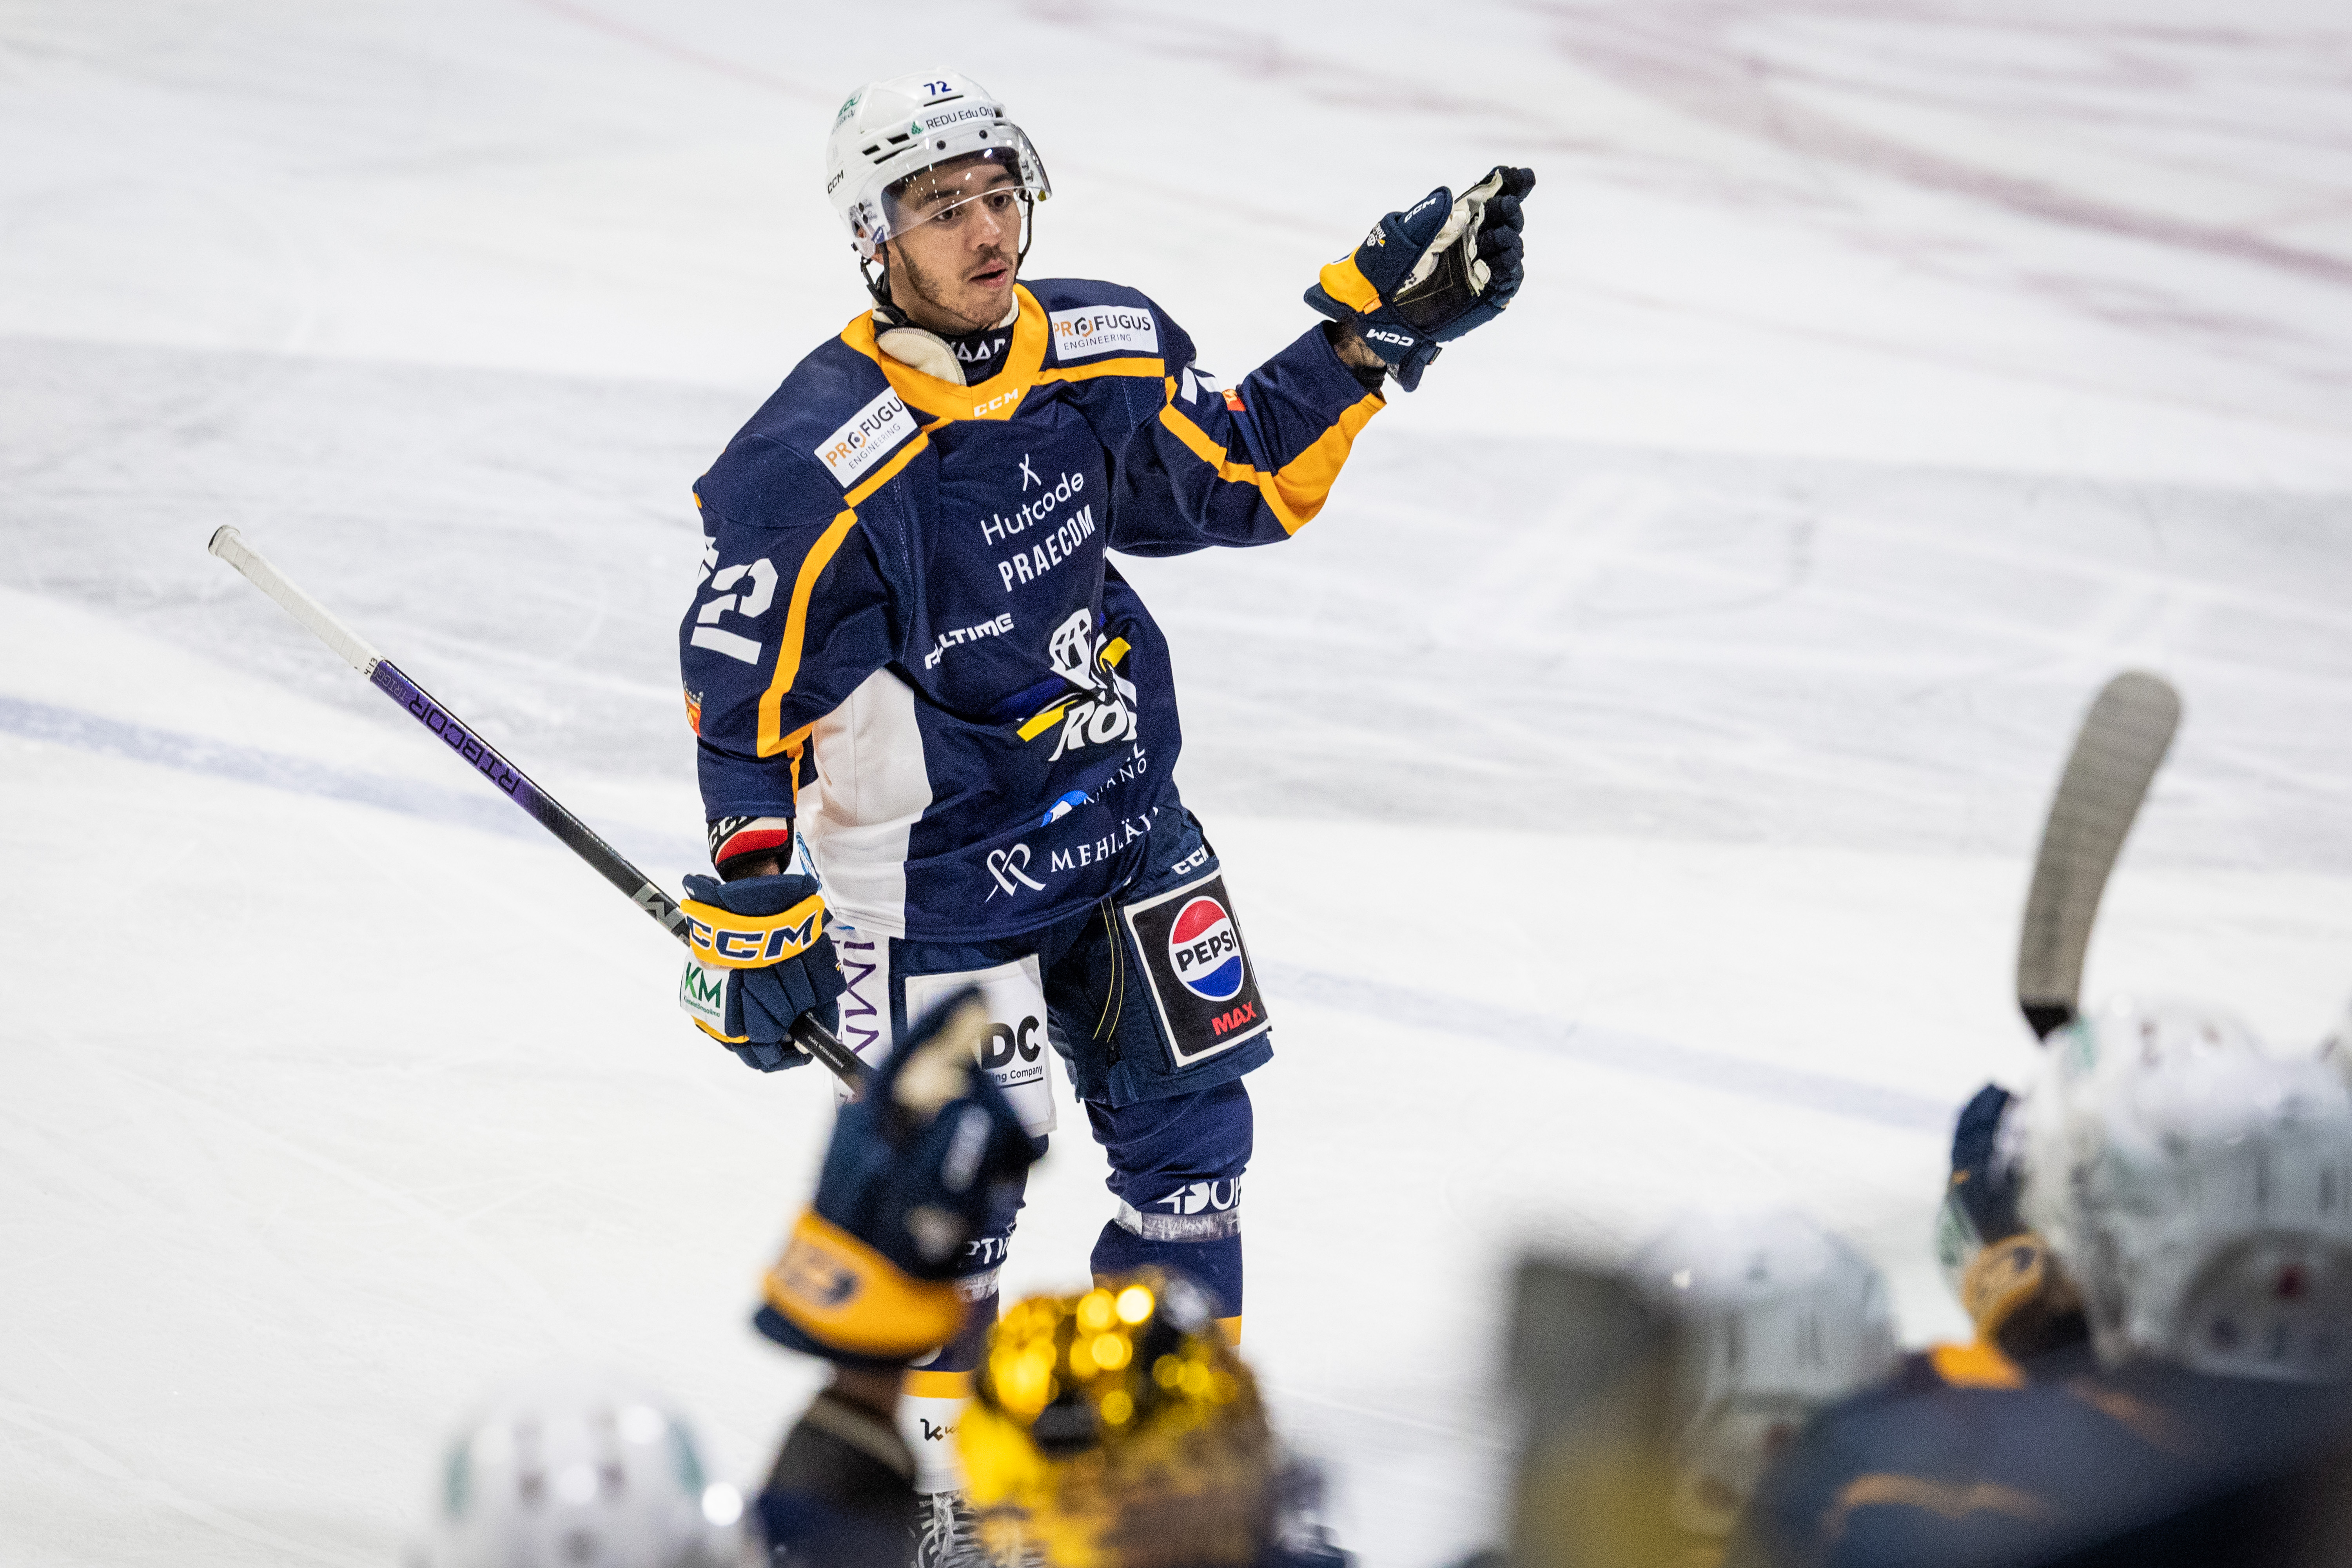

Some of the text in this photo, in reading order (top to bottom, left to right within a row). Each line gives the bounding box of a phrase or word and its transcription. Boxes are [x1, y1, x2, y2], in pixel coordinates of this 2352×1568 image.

[924, 81, 952, 96] 72
[926, 107, 994, 129] REDU Edu Oy
[827, 169, 844, 194] CCM
[1404, 197, 1436, 223] CCM
[1054, 315, 1151, 338] PROFUGUS
[1064, 334, 1132, 350] ENGINEERING
[1366, 328, 1414, 347] CCM
[974, 388, 1018, 417] CCM
[826, 397, 903, 467] PROFUGU
[849, 423, 901, 469] ENGINEERING
[980, 472, 1084, 545] Hutcode
[998, 505, 1096, 592] PRAECOM
[409, 693, 520, 795] RIBCOR
[1048, 701, 1137, 761] RO
[710, 816, 747, 851] CC
[686, 909, 819, 962] CCM
[1176, 928, 1237, 972] PEPSI
[685, 961, 722, 1009] KM
[1211, 1002, 1257, 1036] MAX
[1010, 1065, 1043, 1079] Company
